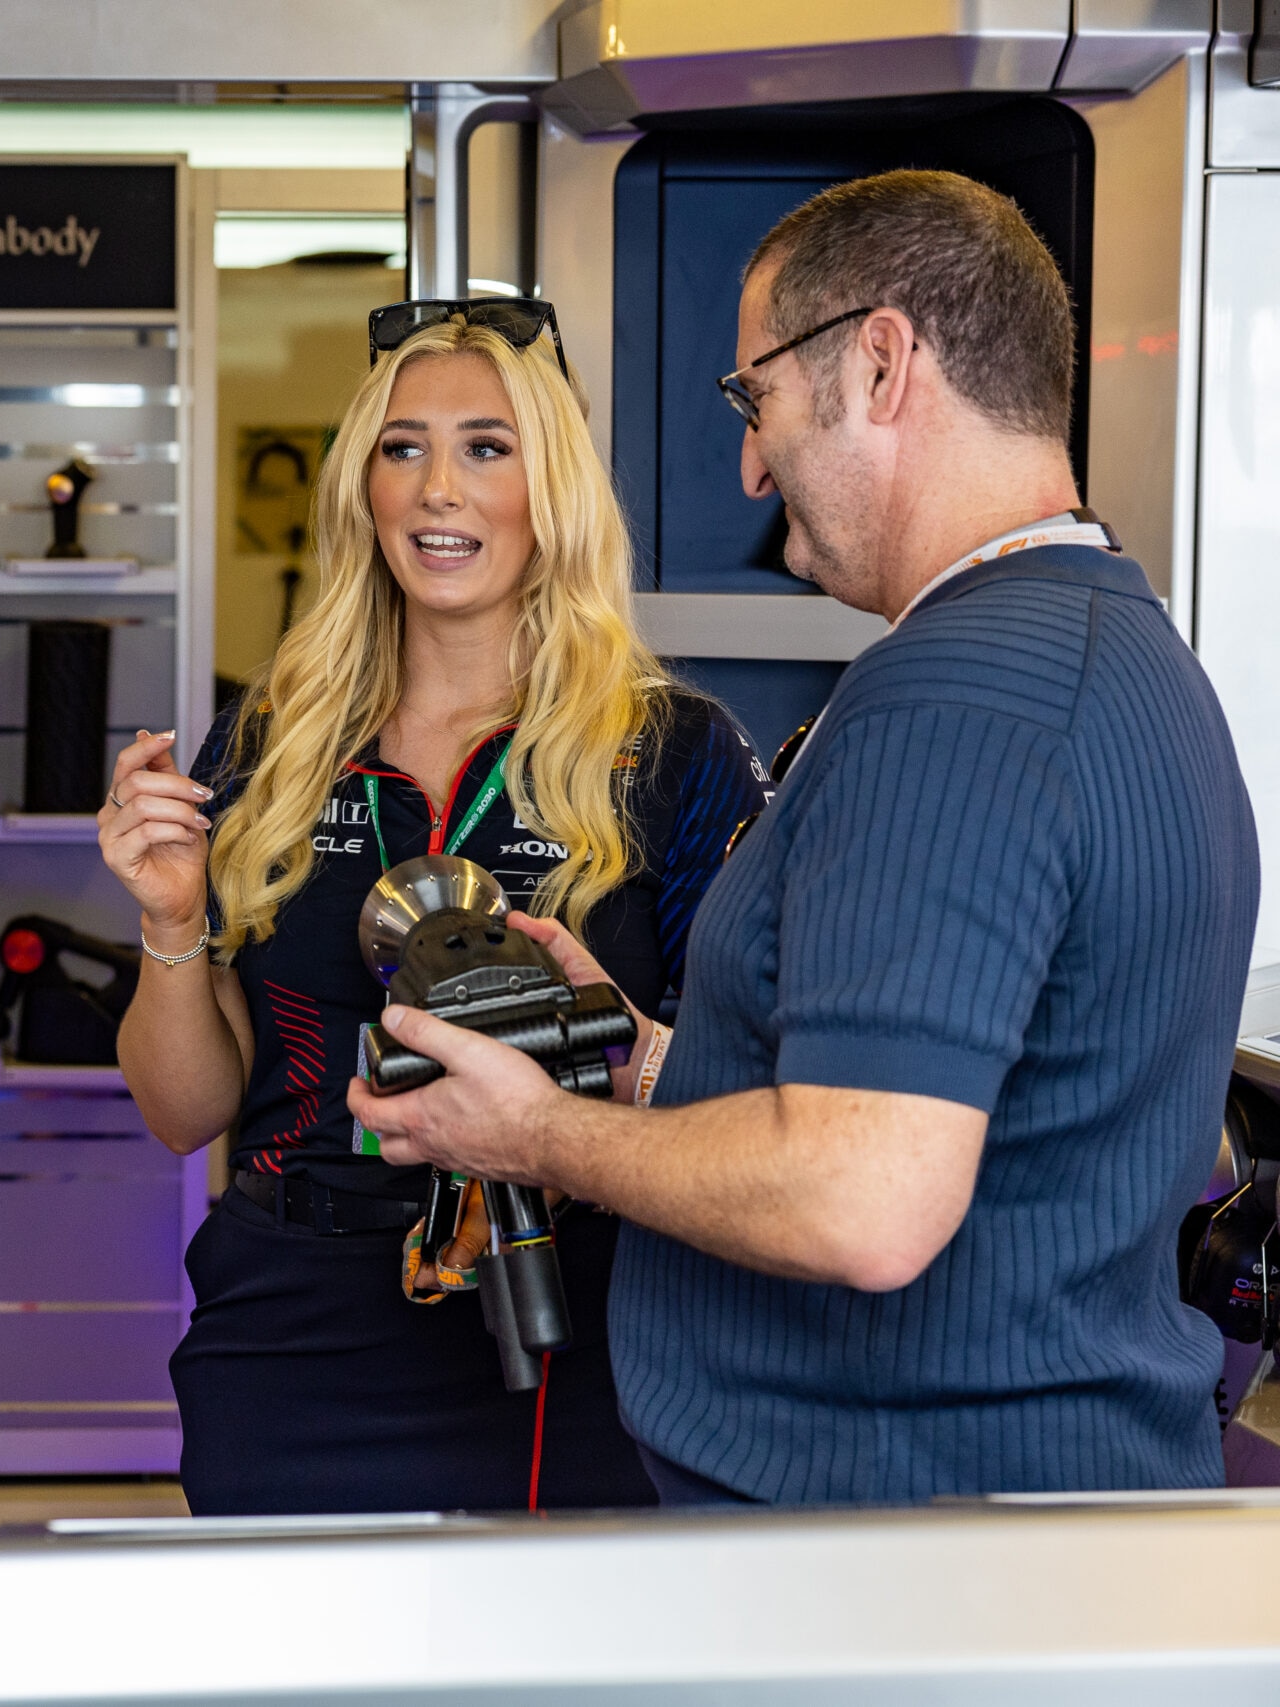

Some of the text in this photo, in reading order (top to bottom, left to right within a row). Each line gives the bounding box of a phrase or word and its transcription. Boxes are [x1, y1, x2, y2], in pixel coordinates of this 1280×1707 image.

[476, 787, 497, 814] 2030
[312, 835, 365, 854] CLE
[498, 841, 588, 861] HON
